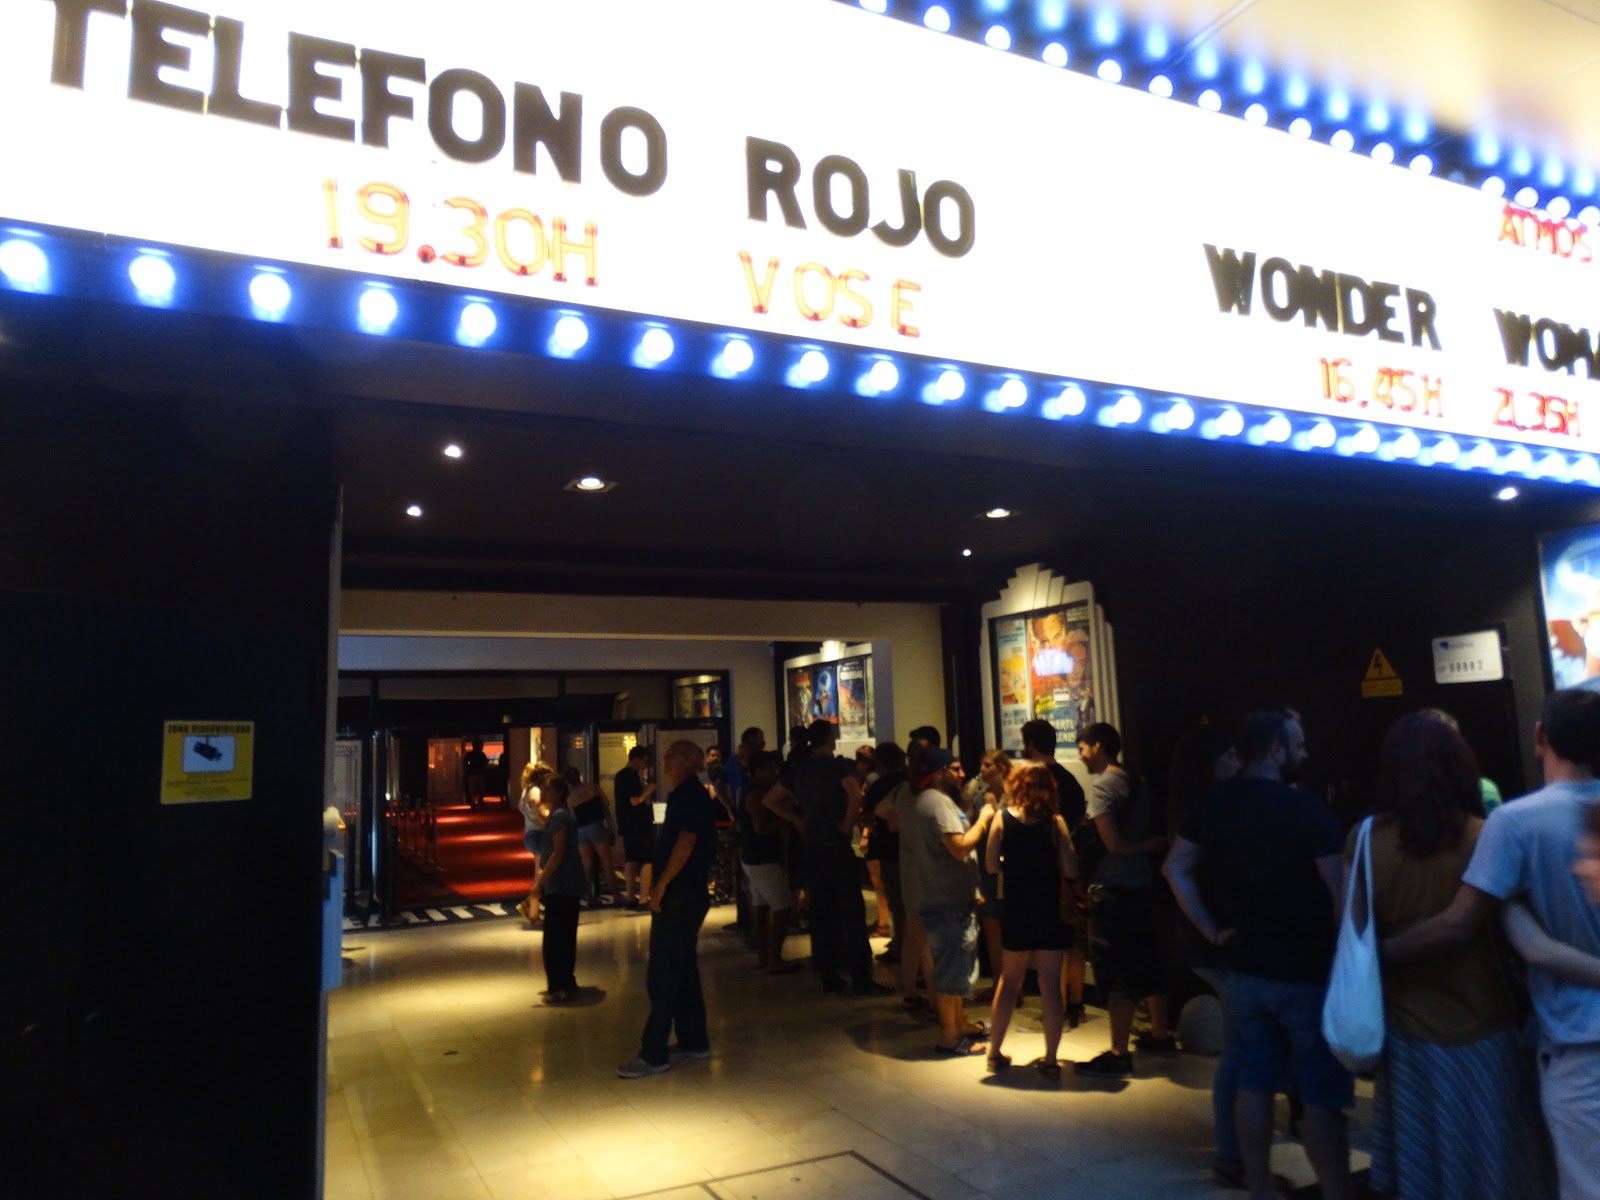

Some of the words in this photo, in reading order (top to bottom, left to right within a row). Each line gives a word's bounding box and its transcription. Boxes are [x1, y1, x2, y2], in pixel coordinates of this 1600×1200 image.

[42, 0, 668, 198] TELEFONO
[745, 135, 976, 259] ROJO
[322, 176, 599, 287] 19.30H
[1497, 202, 1592, 264] ATMOS
[1202, 242, 1443, 352] WONDER
[1492, 307, 1600, 382] WOM
[1319, 356, 1444, 418] 16.45H
